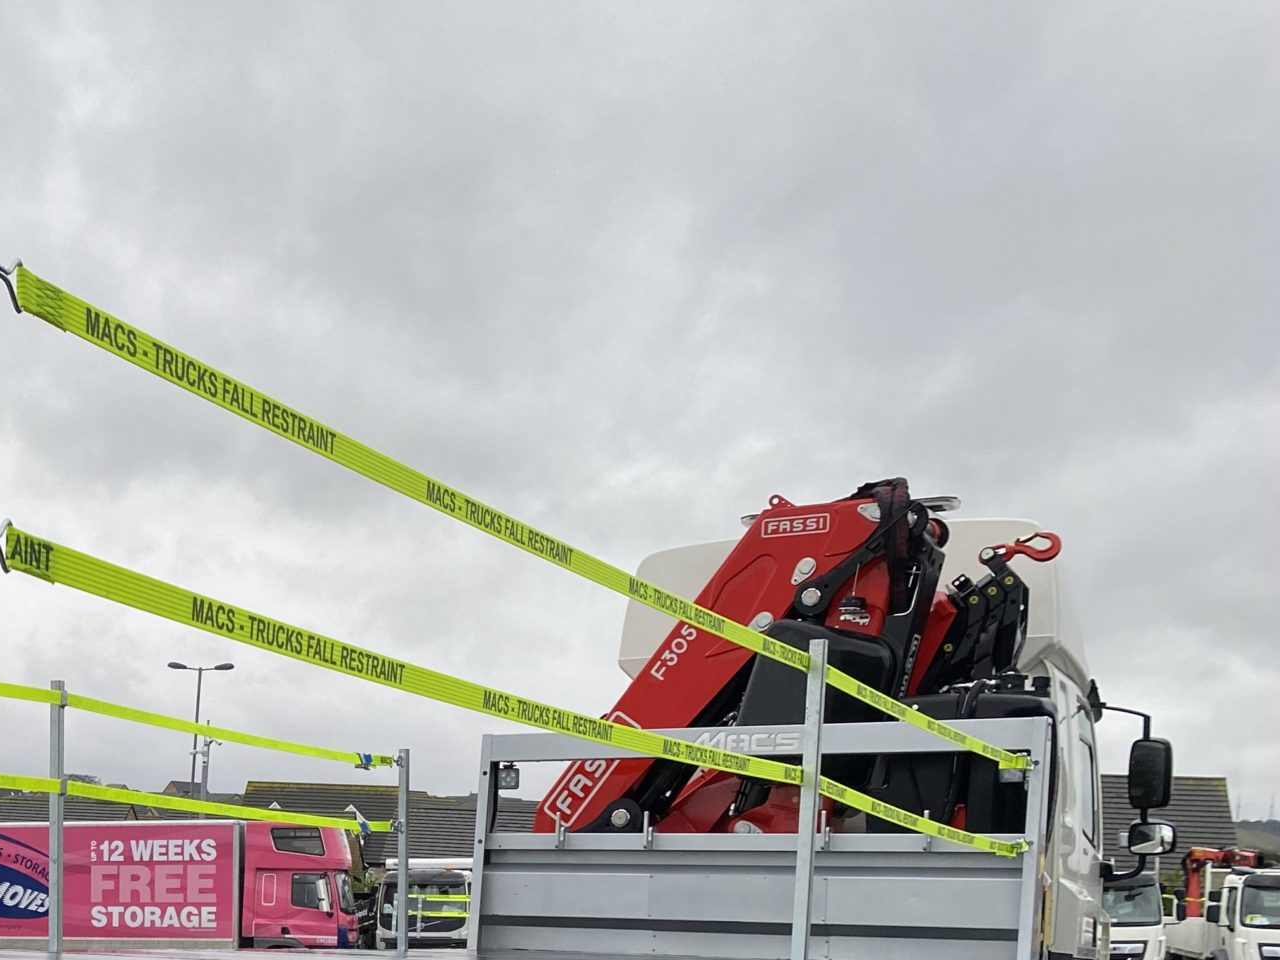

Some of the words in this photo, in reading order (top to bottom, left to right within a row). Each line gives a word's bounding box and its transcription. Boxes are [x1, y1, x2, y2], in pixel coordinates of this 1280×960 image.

[85, 308, 136, 357] MACS
[152, 342, 217, 398] TRUCKS
[222, 377, 258, 419] FALL
[261, 398, 336, 455] RESTRAINT
[426, 480, 456, 513] MACS
[464, 499, 502, 533] TRUCKS
[504, 519, 526, 545] FALL
[528, 531, 573, 566] RESTRAINT
[767, 517, 824, 533] FASSI
[629, 577, 648, 601] MACS
[653, 588, 678, 614] TRUCKS
[679, 604, 693, 620] FALL
[694, 608, 725, 634] RESTRAINT
[191, 596, 235, 633] MACS
[248, 615, 304, 658] TRUCKS
[306, 637, 337, 665] FALL
[340, 646, 405, 685] RESTRAINT
[650, 624, 697, 681] F305
[482, 689, 509, 715] MACS
[516, 699, 550, 727] TRUCKS
[552, 712, 571, 731] FALL
[573, 718, 614, 742] RESTRAINT
[663, 739, 681, 758] MACS
[685, 745, 708, 764] TRUCKS
[708, 753, 721, 766] FALL
[722, 754, 750, 771] RESTRAINT
[556, 760, 606, 815] FAS
[91, 851, 97, 861] UP
[100, 840, 124, 861] 12
[130, 839, 217, 861] WEEKS
[91, 865, 216, 903] FREE
[91, 906, 217, 929] STORAGE
